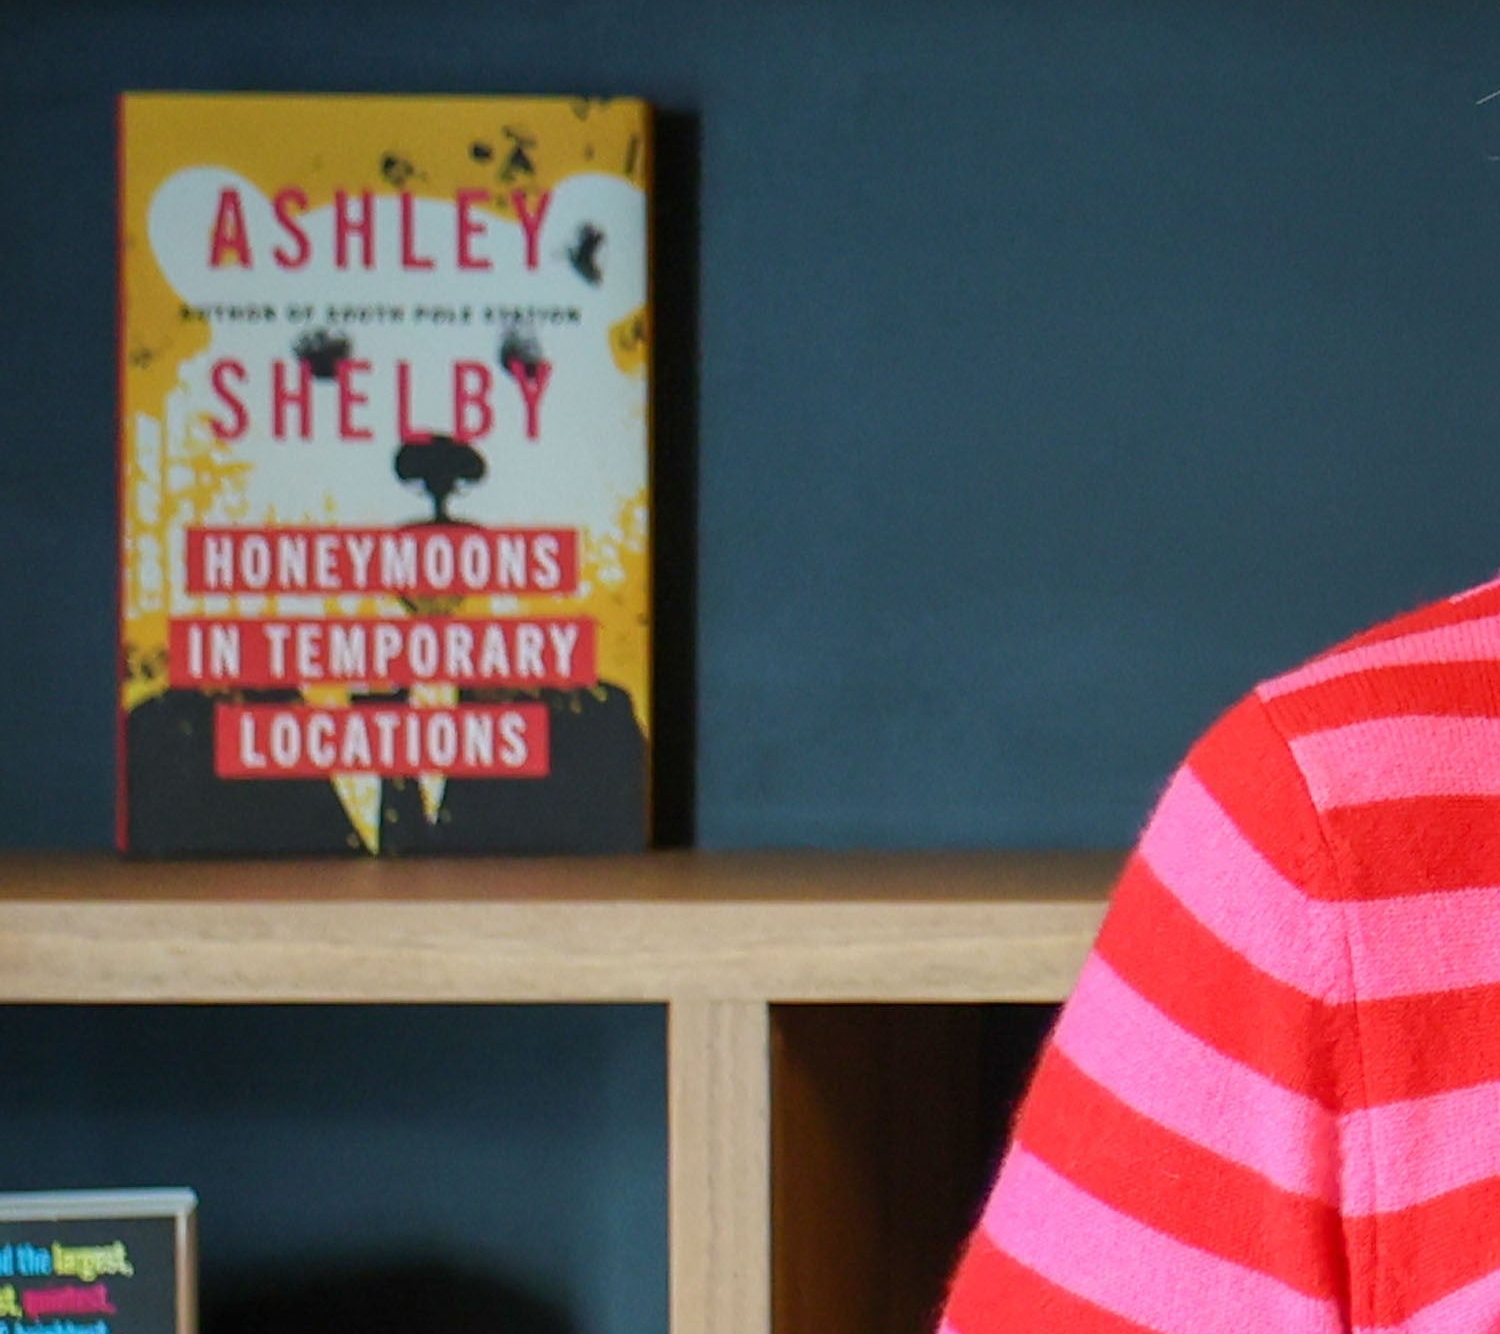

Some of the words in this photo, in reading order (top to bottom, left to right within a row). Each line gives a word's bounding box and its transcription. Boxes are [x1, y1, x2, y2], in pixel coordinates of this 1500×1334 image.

[209, 188, 553, 271] ASHLEY
[209, 359, 554, 444] SHELBY
[204, 533, 561, 589] HONEYMOONS
[187, 624, 240, 679] IN
[264, 623, 579, 679] TEMPORARY
[239, 712, 529, 768] LOCATIONS
